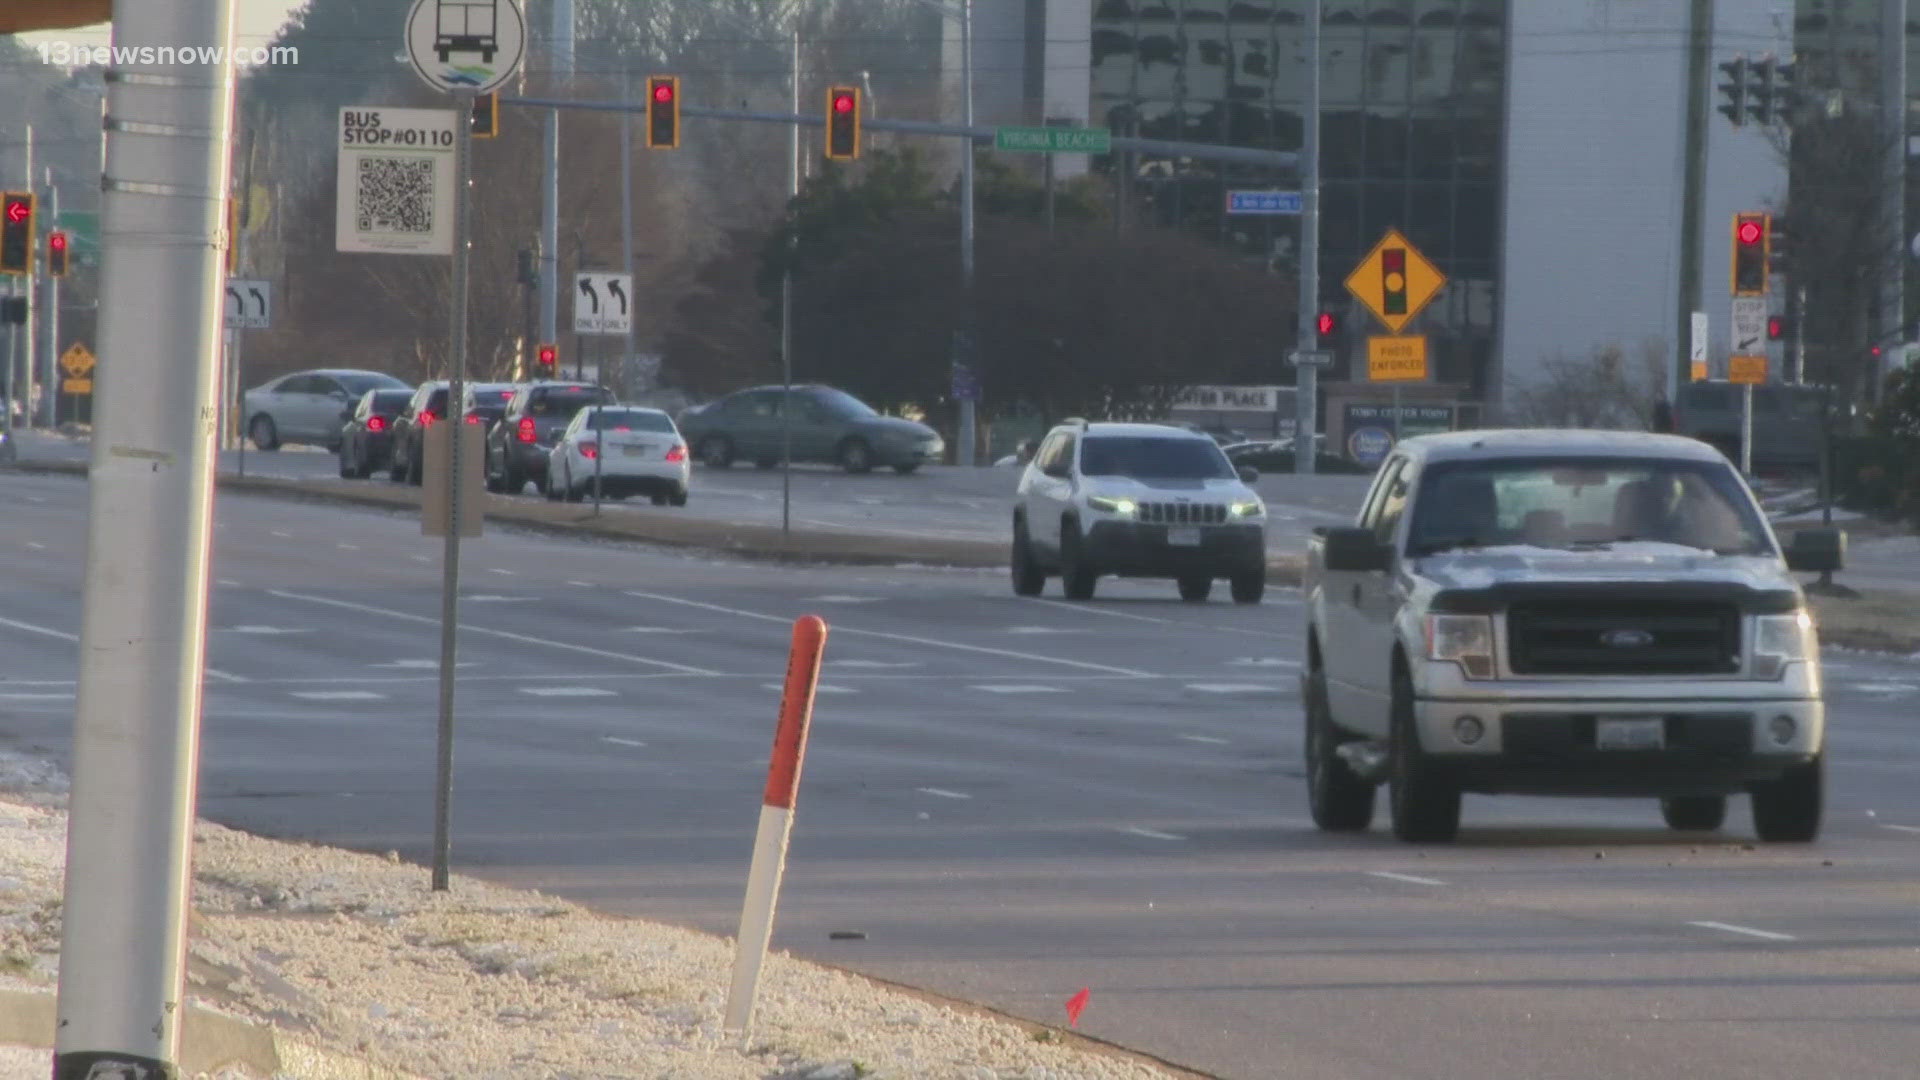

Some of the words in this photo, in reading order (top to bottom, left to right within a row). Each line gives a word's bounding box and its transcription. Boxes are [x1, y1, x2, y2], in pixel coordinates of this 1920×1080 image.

[344, 111, 380, 127] BUS
[1003, 132, 1050, 146] VIRGINIA
[1056, 132, 1095, 147] BEACH
[1736, 302, 1762, 312] STOP
[1738, 323, 1760, 333] RED
[1381, 346, 1412, 356] PHOTO
[1371, 360, 1423, 371] ENFORCED
[1222, 390, 1269, 406] PLACE
[1381, 407, 1417, 417] CETER
